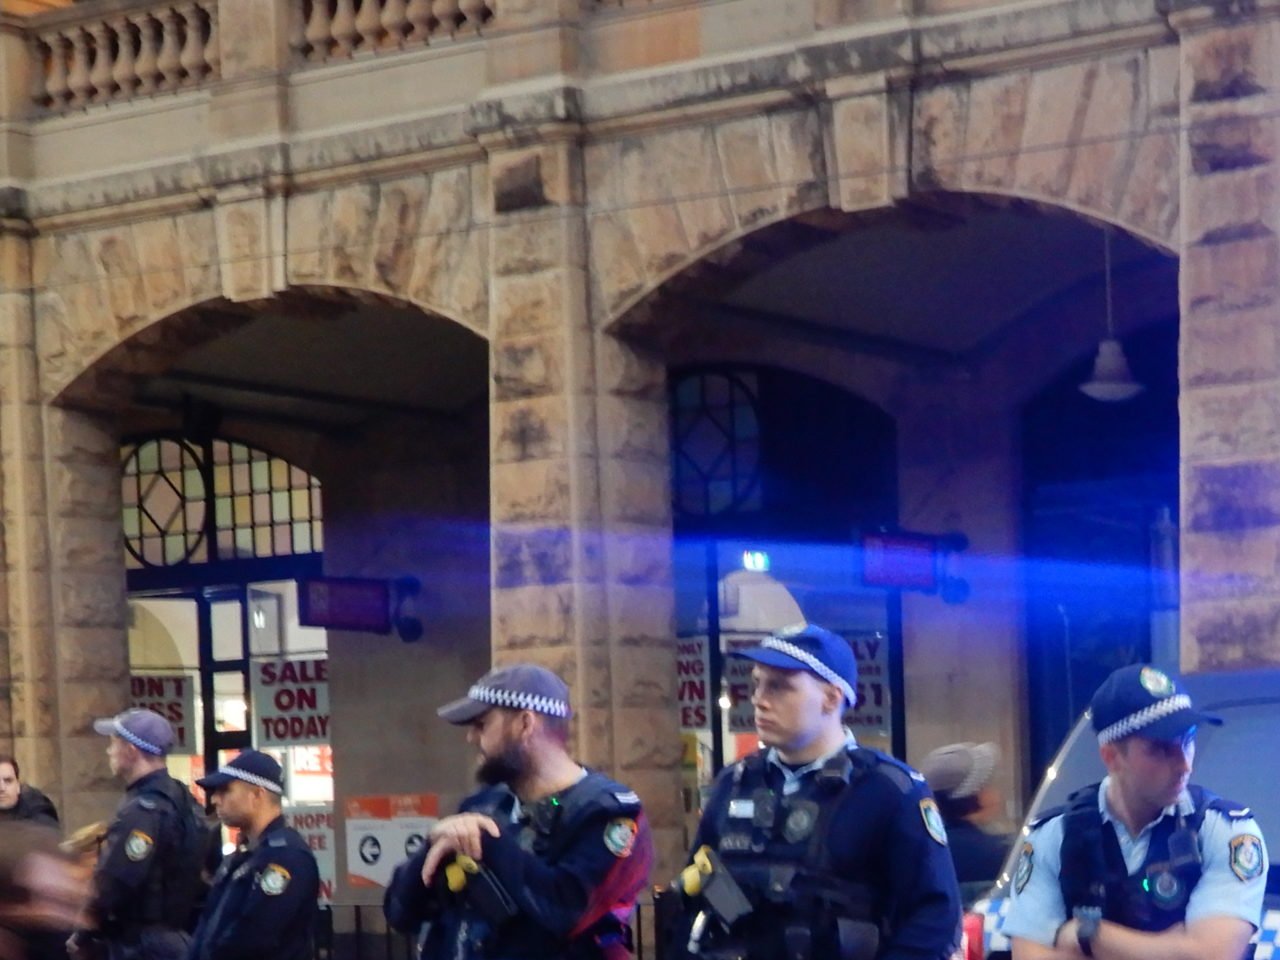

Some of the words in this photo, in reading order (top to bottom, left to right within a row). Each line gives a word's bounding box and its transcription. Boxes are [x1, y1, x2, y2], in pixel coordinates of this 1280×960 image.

[261, 659, 328, 686] SALE
[274, 687, 317, 712] ON
[261, 714, 330, 741] TODAY
[681, 705, 707, 728] ES
